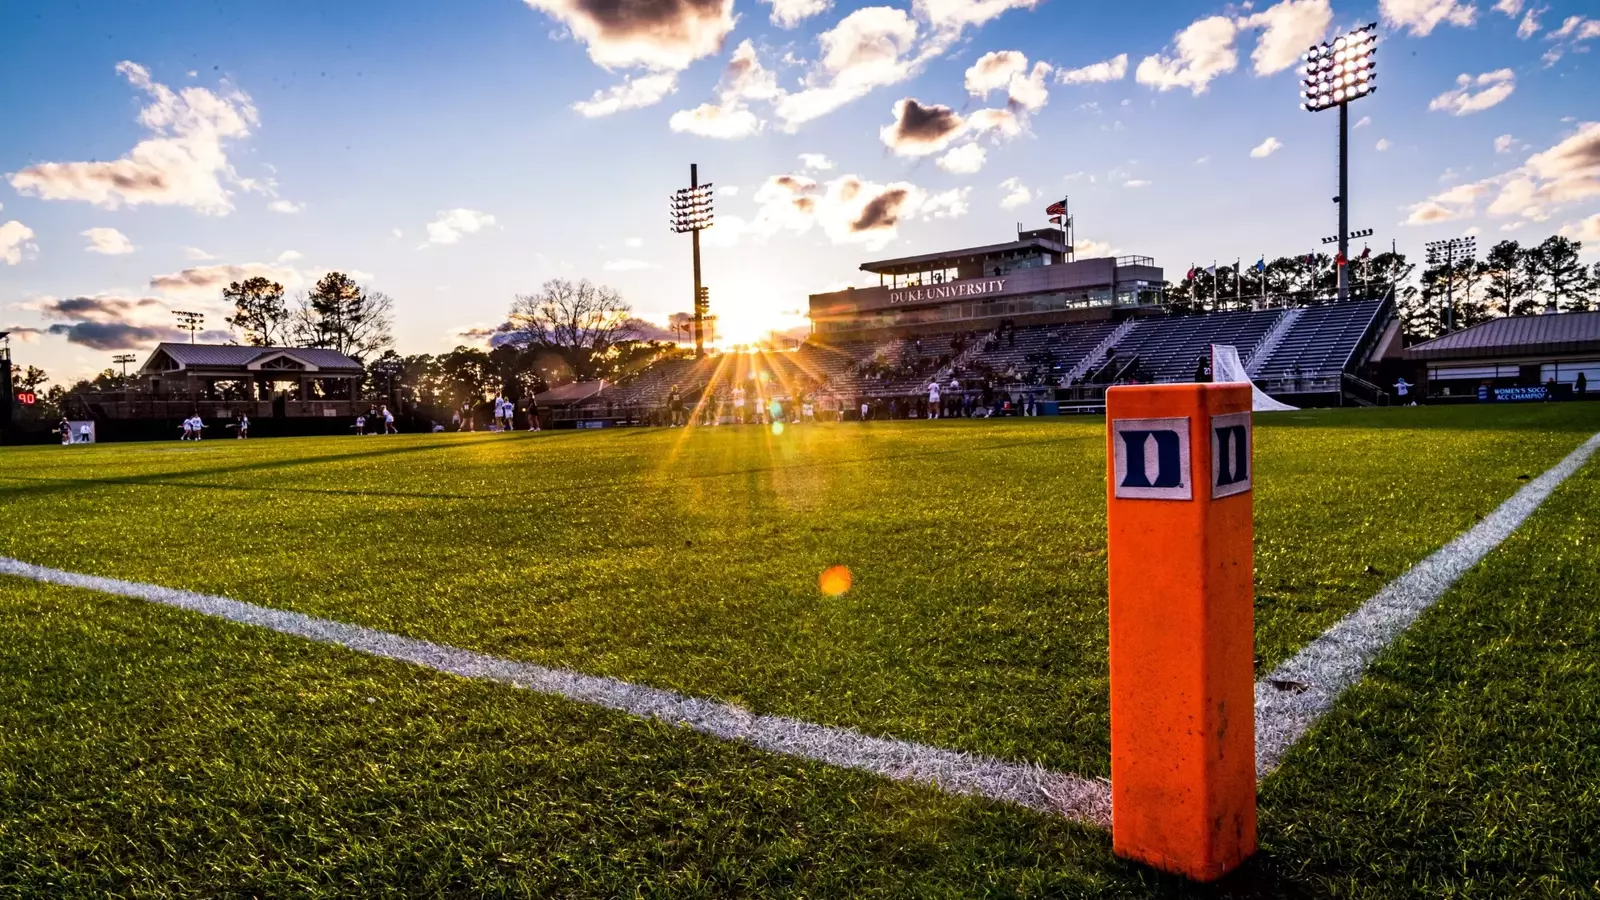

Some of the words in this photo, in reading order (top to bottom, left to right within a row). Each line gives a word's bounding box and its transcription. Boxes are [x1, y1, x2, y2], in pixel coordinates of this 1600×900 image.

[891, 289, 924, 303] DUKE
[927, 280, 1005, 299] UNIVERSITY
[18, 393, 35, 404] 90
